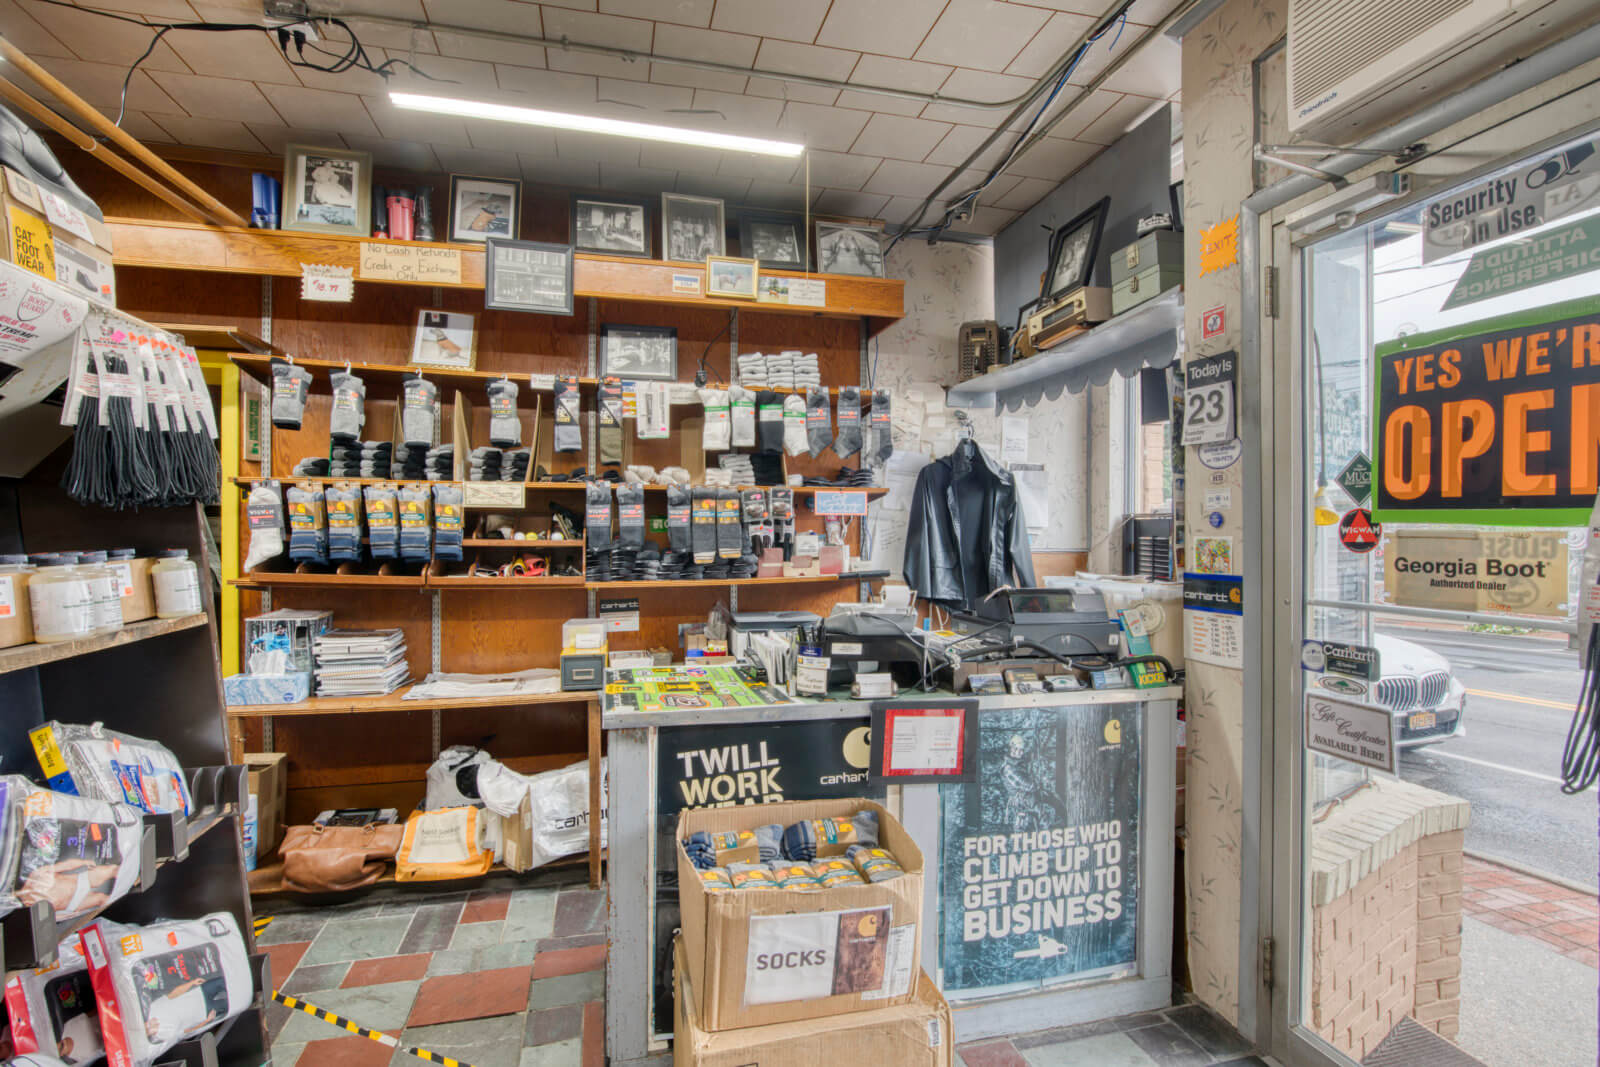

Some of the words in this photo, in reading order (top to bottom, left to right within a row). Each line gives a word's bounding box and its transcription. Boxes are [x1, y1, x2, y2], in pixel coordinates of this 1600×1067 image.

[1430, 178, 1517, 228] Security
[15, 226, 32, 243] CAT
[1472, 220, 1489, 244] in
[1497, 204, 1536, 234] Use
[16, 239, 40, 259] FOOT
[368, 242, 381, 253] No
[384, 243, 410, 256] Cash
[1206, 234, 1232, 254] EXIT
[17, 252, 44, 273] WEAR
[1190, 363, 1221, 380] Today
[1222, 359, 1232, 372] Is
[1394, 349, 1462, 395] YES
[1188, 390, 1224, 425] 23
[1341, 526, 1380, 534] WIGWAM
[1394, 556, 1477, 578] Georgia
[1486, 559, 1546, 578] Boot
[1430, 578, 1475, 590] Authorized
[1476, 580, 1507, 591] Dealer
[1312, 702, 1336, 722] Gift
[1312, 733, 1357, 754] AVAILABLE
[1360, 746, 1385, 762] HERE
[677, 741, 779, 778] TWILL
[680, 767, 784, 806] WORK
[820, 771, 869, 785] carhar
[964, 834, 1006, 857] FOR
[1011, 827, 1076, 853] THOSE
[1079, 820, 1121, 842] WHO
[964, 851, 1048, 884] CLIMB
[1055, 846, 1090, 873] UP
[1094, 840, 1122, 867] TO
[964, 882, 1012, 909] GET
[1017, 872, 1090, 902] DOWN
[1094, 866, 1122, 892] TO
[964, 890, 1122, 942] BUSINESS
[756, 950, 826, 970] SOCKS
